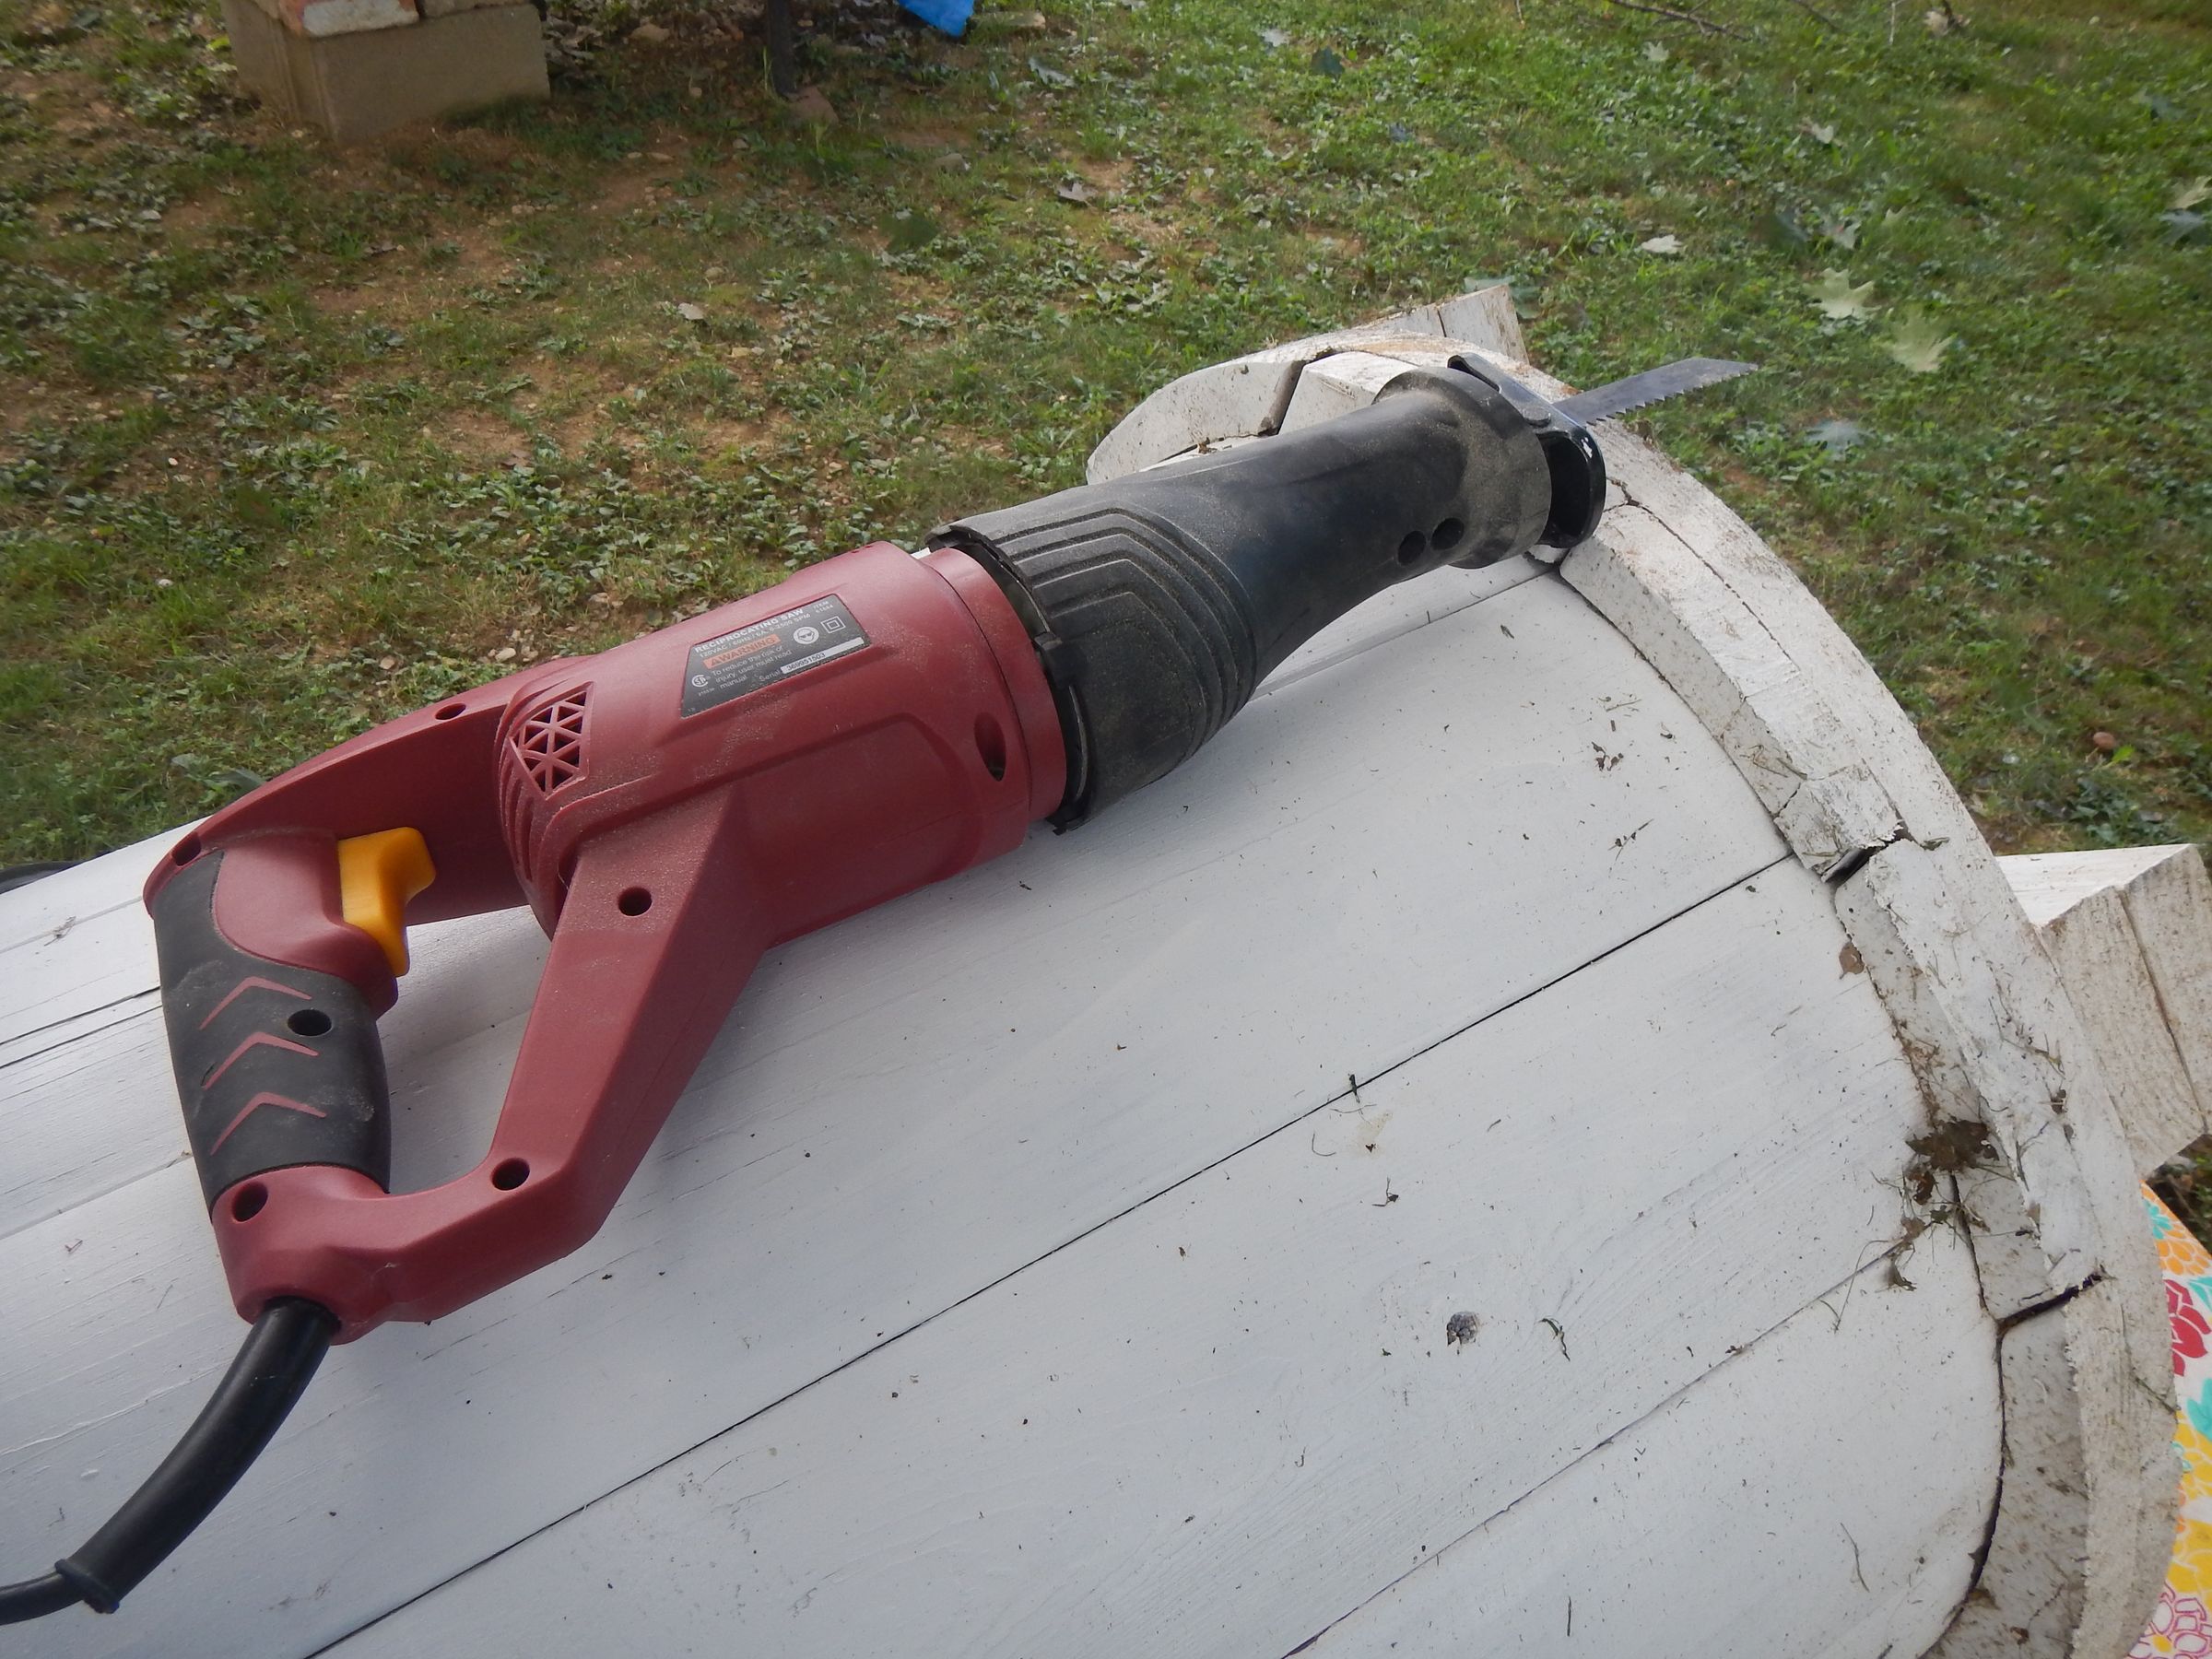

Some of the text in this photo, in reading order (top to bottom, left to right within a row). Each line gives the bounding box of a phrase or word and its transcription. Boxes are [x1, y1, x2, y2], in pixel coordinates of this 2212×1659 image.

[695, 608, 804, 653] RECIPROCATING SAW
[700, 644, 727, 657] 120VAC
[719, 637, 776, 661] WARNING
[723, 658, 747, 672] reduce
[738, 665, 754, 674] user
